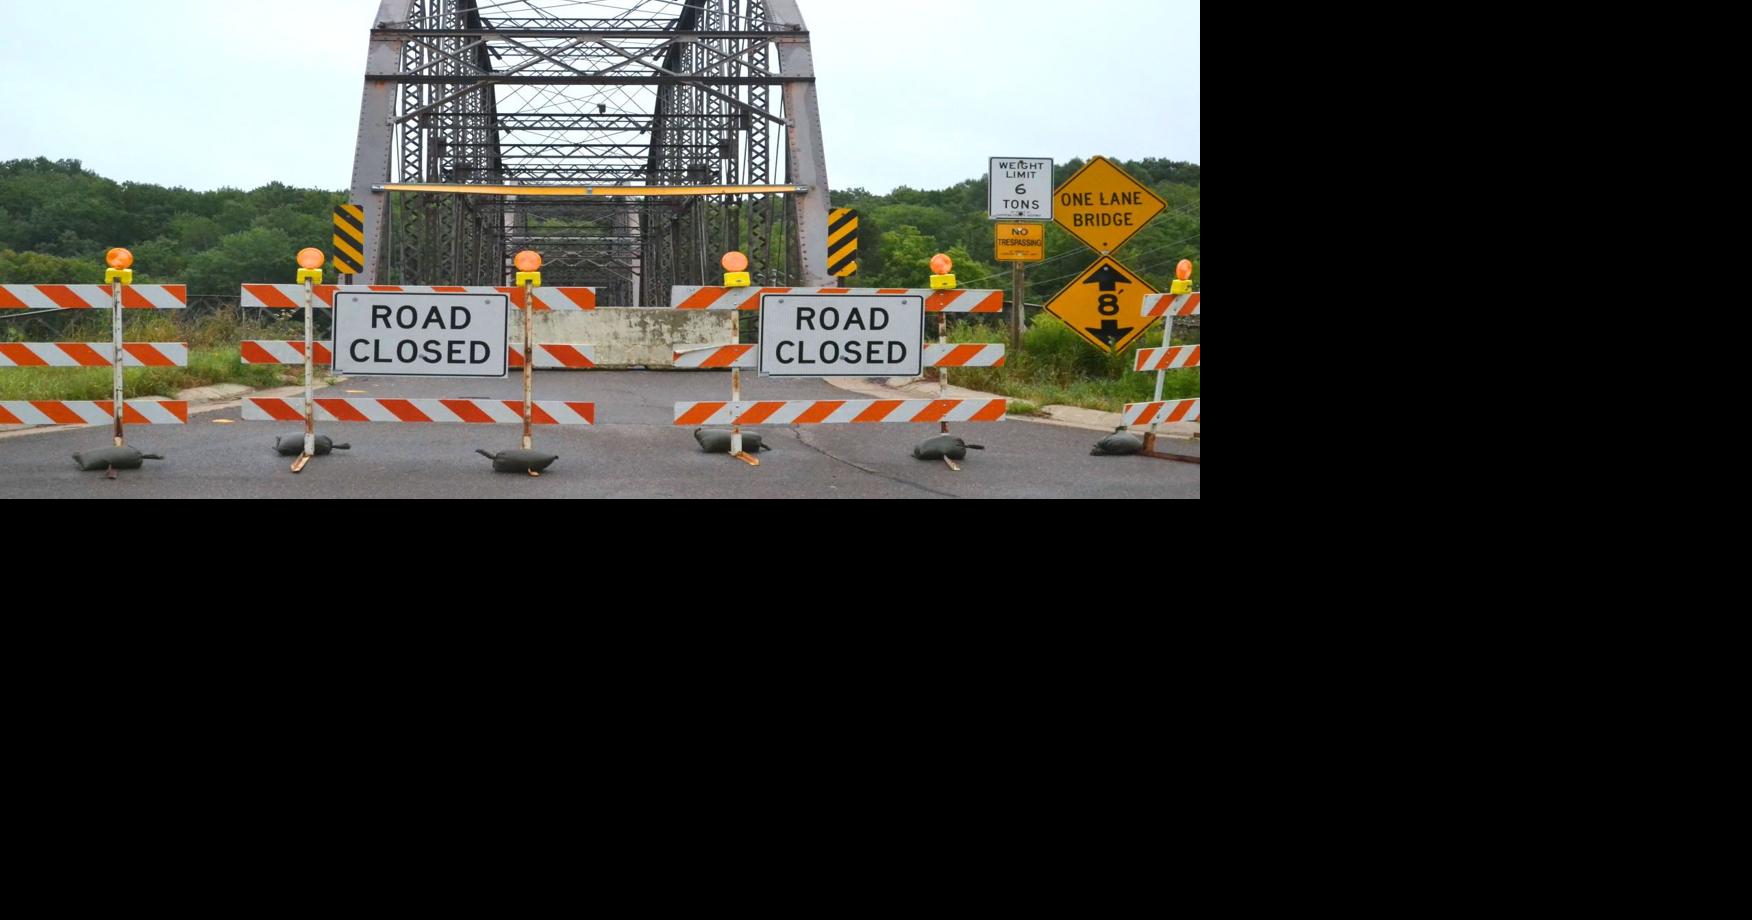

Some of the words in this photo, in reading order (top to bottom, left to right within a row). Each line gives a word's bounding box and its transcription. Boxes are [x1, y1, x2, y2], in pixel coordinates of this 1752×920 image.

[999, 162, 1044, 170] WEIGHT
[1006, 171, 1037, 179] LIMIT
[1015, 183, 1027, 195] 6
[1003, 199, 1040, 210] TONS
[1060, 192, 1093, 207] ONE
[1100, 191, 1142, 206] LANE
[1073, 212, 1134, 227] BRIDGE
[1011, 228, 1029, 236] NO
[997, 238, 1042, 247] TRESPASSING
[371, 304, 472, 330] ROAD
[796, 306, 889, 331] ROAD
[350, 338, 491, 364] CLOSED
[775, 340, 907, 364] CLOSED
